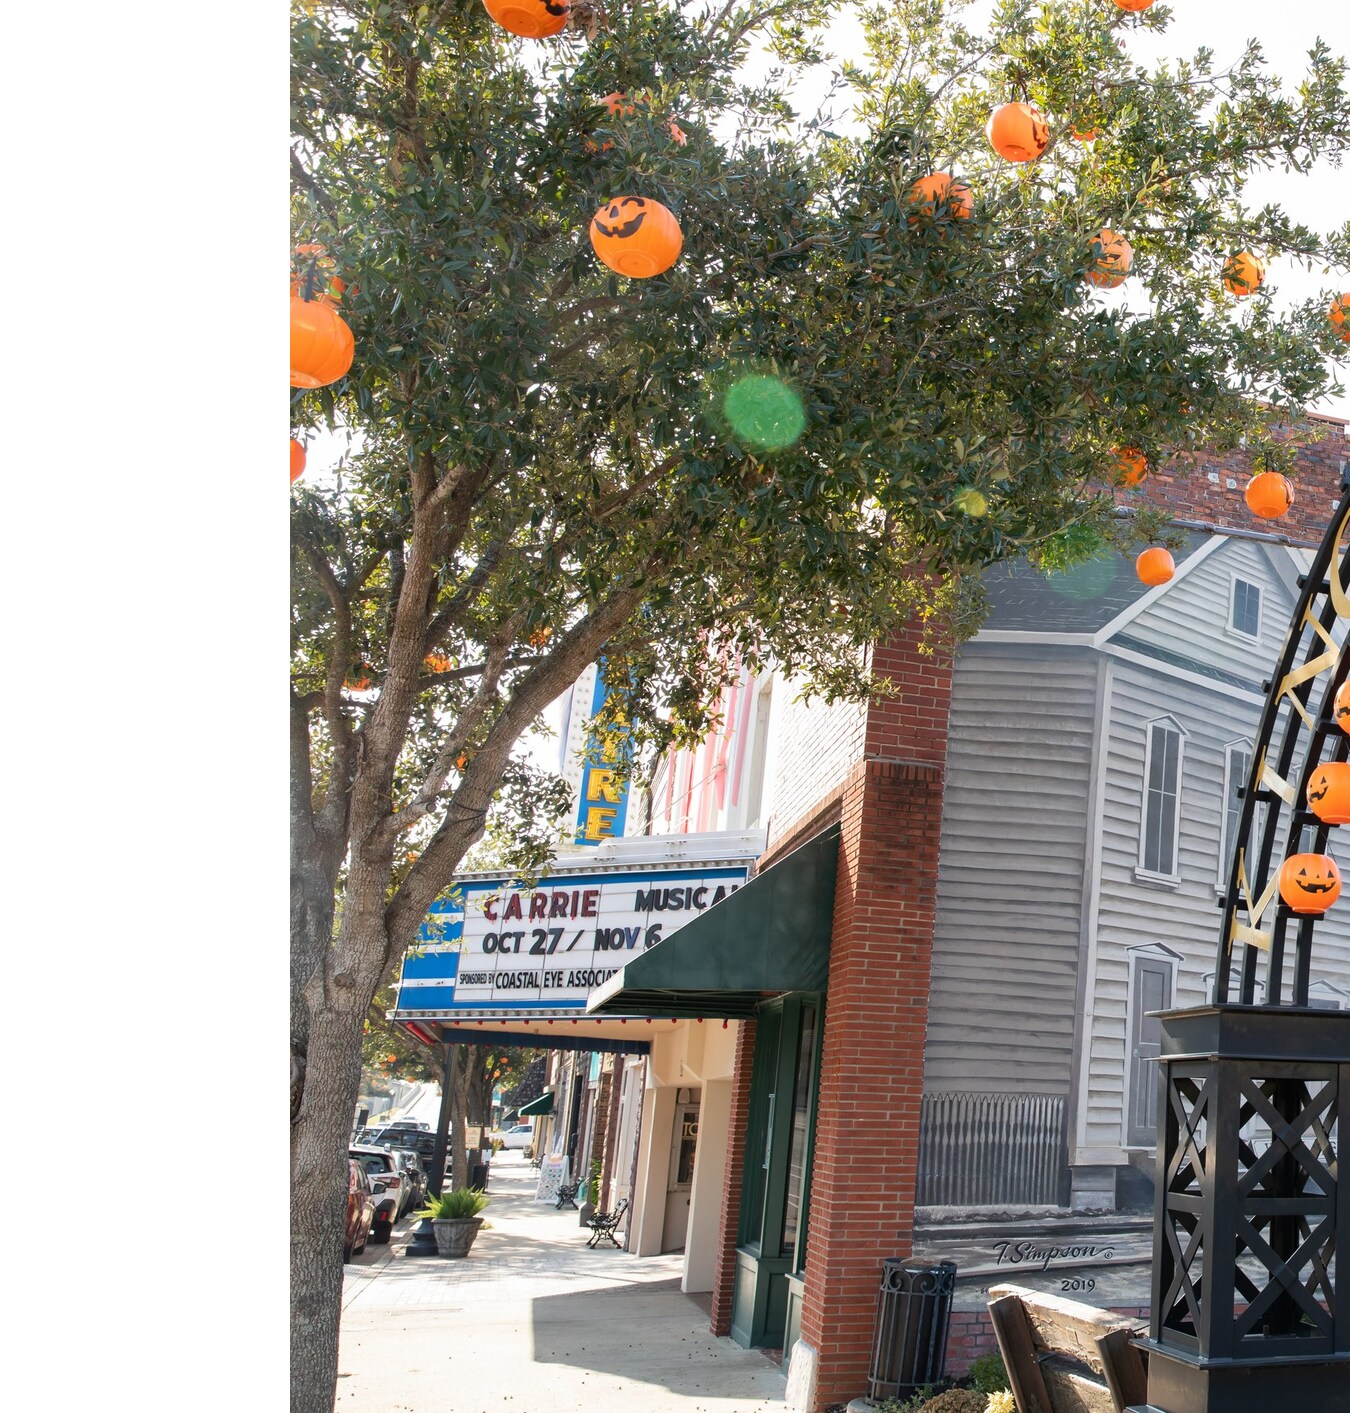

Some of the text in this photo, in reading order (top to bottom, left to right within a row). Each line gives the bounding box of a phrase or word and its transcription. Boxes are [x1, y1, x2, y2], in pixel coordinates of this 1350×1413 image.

[483, 889, 598, 922] CARRIE
[482, 931, 525, 954] OCT
[529, 927, 564, 955] 27
[594, 927, 640, 951] NOV
[645, 923, 662, 949] 6
[459, 972, 486, 985] SPONSORED
[488, 971, 495, 984] BY
[495, 972, 540, 989] COASTAL
[543, 971, 563, 988] EYE
[1061, 1278, 1096, 1293] 2019
